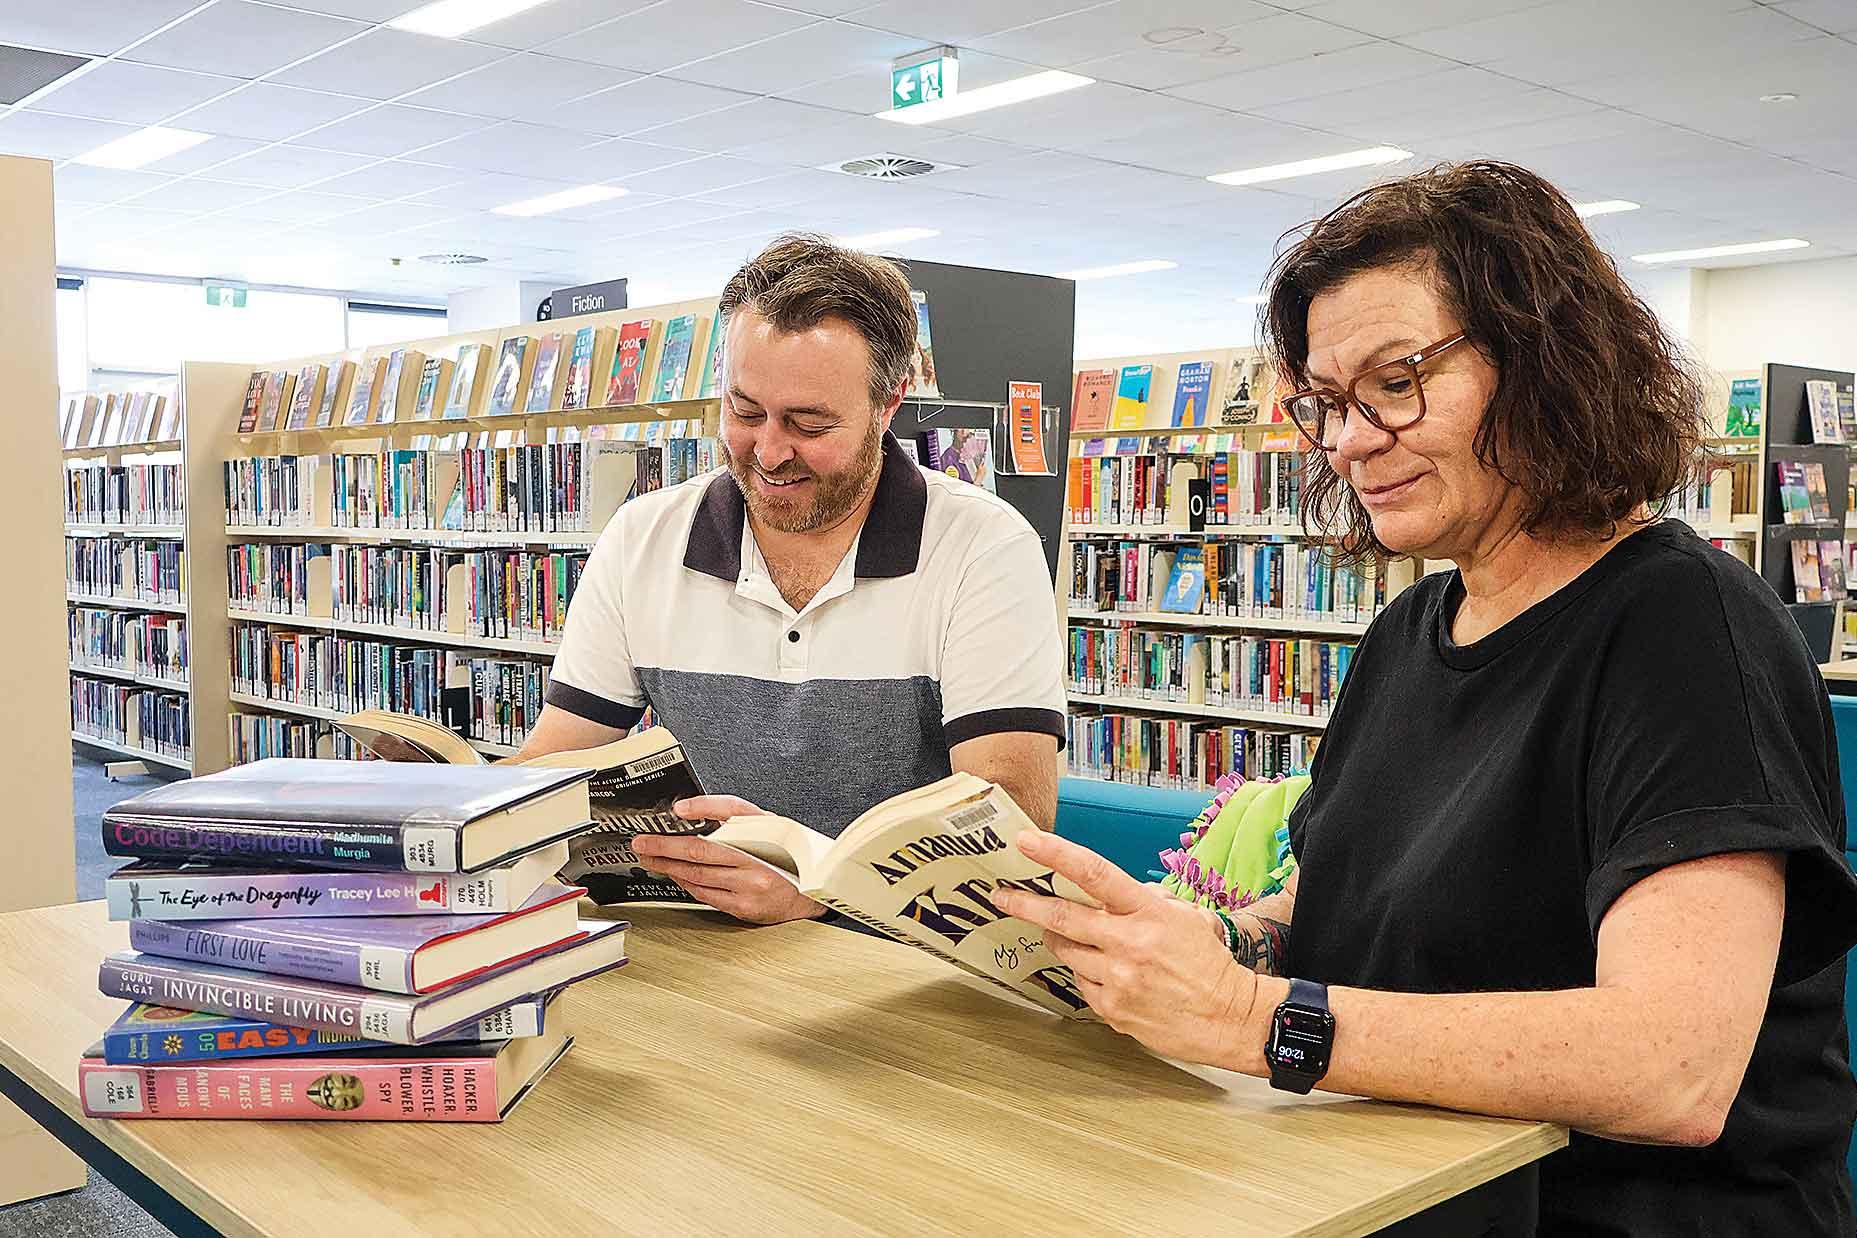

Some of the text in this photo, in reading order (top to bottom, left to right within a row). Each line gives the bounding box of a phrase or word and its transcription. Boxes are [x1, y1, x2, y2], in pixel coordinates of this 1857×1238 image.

[572, 294, 605, 313] Fiction
[475, 673, 483, 698] CULT
[447, 706, 463, 730] L
[602, 777, 624, 785] ACTUAL
[616, 778, 643, 789] ORIGINAL
[114, 822, 326, 857] Code Dependent
[333, 846, 371, 859] Murgia
[582, 845, 608, 857] HOW
[583, 851, 640, 868] PABLO
[159, 885, 323, 909] The Eye of the Dragonfly
[328, 887, 371, 901] Tracey
[376, 888, 400, 899] Lee
[458, 886, 466, 903] 070
[468, 883, 476, 904] 4497
[186, 930, 224, 957] FIRST
[232, 937, 270, 964] LOVE
[993, 943, 1019, 970] My
[121, 971, 152, 986] GURU
[119, 983, 154, 997] JAGAT
[163, 979, 355, 1027] INVINCIBLE LIVING
[198, 1032, 215, 1052] 50
[217, 1027, 313, 1051] EASY
[1278, 1045, 1305, 1060] 12:06
[106, 1081, 116, 1105] COLE
[175, 1077, 190, 1108] MOUS
[217, 1086, 230, 1101] OF
[239, 1075, 252, 1110] FACES
[258, 1077, 272, 1108] MANY
[279, 1083, 293, 1103] THE
[378, 1082, 392, 1104] SPY
